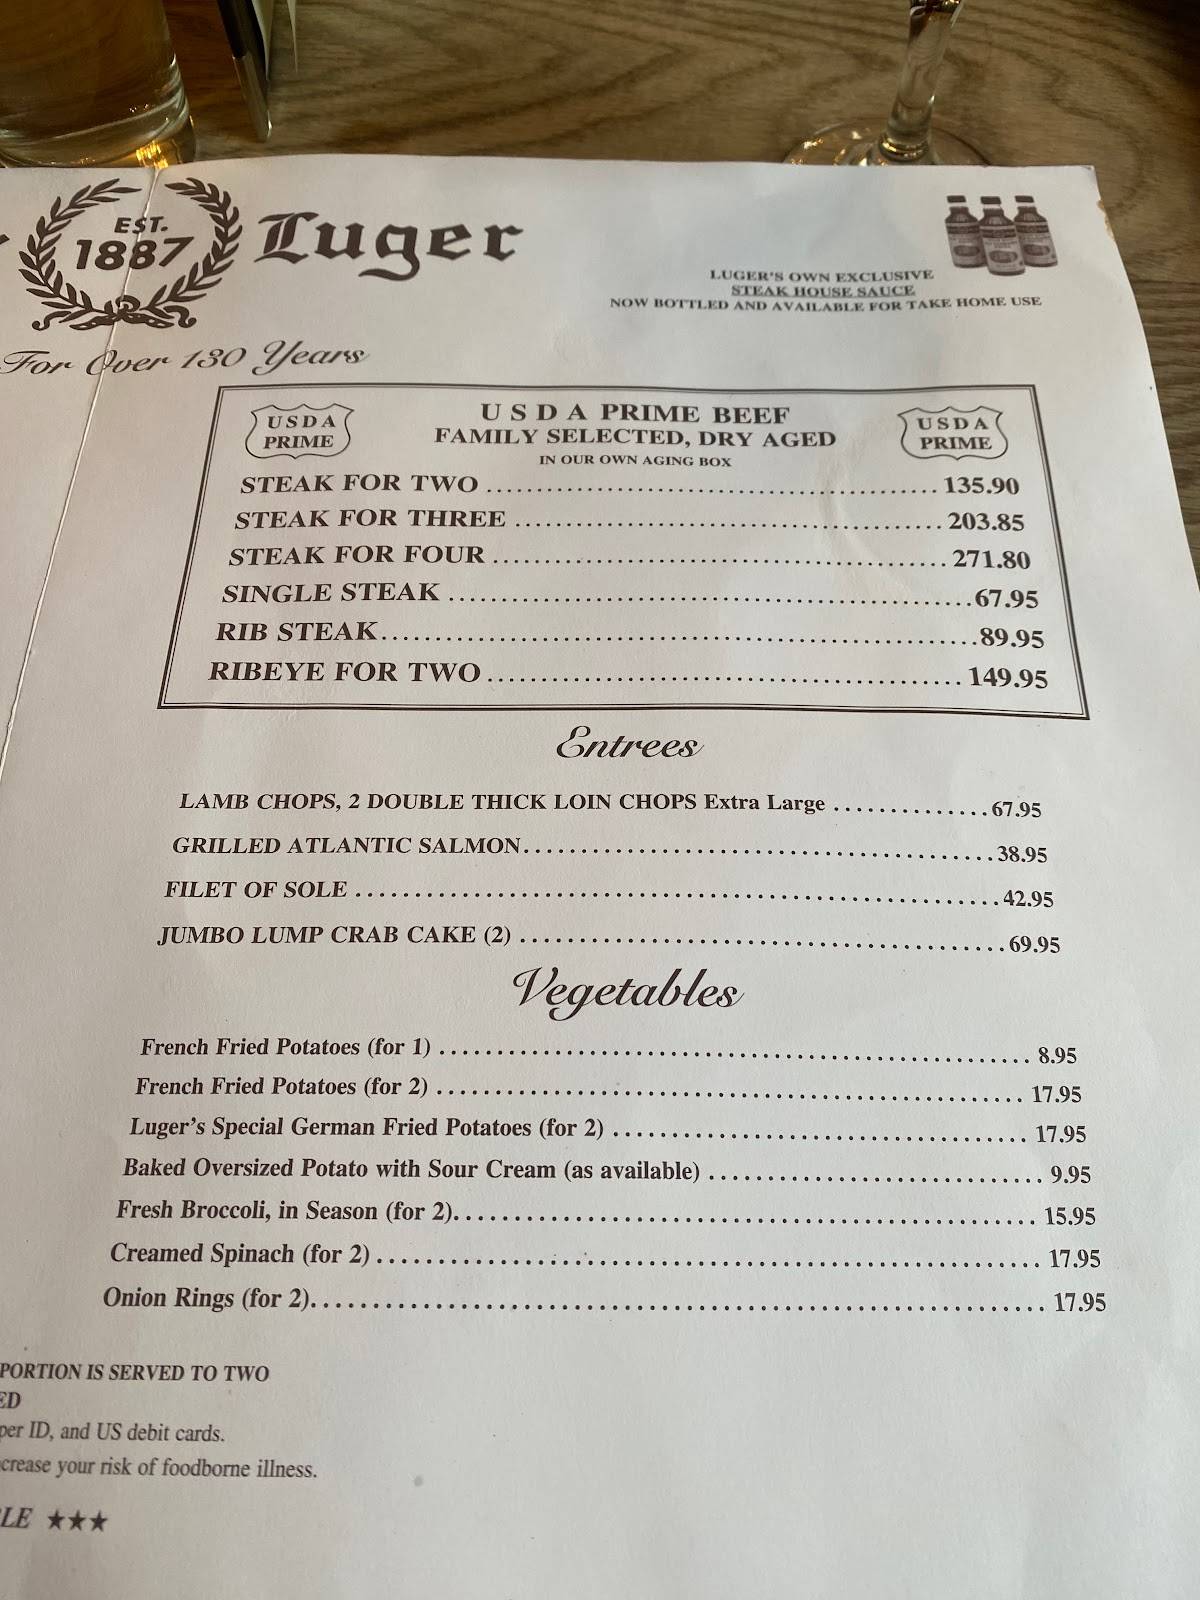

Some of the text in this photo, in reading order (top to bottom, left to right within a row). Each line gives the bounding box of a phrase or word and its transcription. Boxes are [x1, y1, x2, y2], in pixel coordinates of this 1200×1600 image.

[113, 217, 169, 234] EST.
[75, 236, 194, 270] 1887
[254, 212, 524, 281] Luger
[710, 269, 934, 283] LUGER'S OWN EXCLUSIVE
[610, 296, 1043, 313] NOW BOTTLED AND AVAILABLE FOR TAKE HOME USE
[731, 285, 916, 299] STEAK HOUSE SAUCE
[0, 340, 370, 376] For Over 130 Years
[601, 404, 700, 422] PRIME
[712, 407, 789, 424] BEEF
[263, 435, 334, 450] PRIME
[434, 428, 836, 448] FAMILY SELECTED, DRY AGED
[920, 436, 993, 451] PRIME
[539, 454, 732, 468] IN OUR OWN AGING BOX
[240, 474, 1019, 495] STEAK FOR TWO 135.90
[235, 509, 1024, 531] STEAK FOR THREE 203.85
[229, 545, 1031, 569] STEAK FOR FOUR 271.80
[222, 582, 1038, 608] SINGLE STEAK 67.95
[215, 623, 267, 641] RIB
[980, 628, 1044, 648] 89.95
[208, 662, 1048, 689] RIBEYE FOR TWO 149.95
[556, 726, 704, 759] Entrees
[179, 793, 1041, 818] LAMB CHOPS, 2 DOUBLE THICK LOIN CHOPS Extra Large 67.95
[173, 837, 280, 854] GRILLED
[286, 837, 411, 854] ATLANTIC
[997, 846, 1047, 863] 38.95
[164, 880, 1053, 908] FILET OF SOLE 42.95
[157, 925, 1060, 953] JUMBO LUMP CRAB CAKE (2) 69.95
[513, 967, 744, 1021] Vegetables
[140, 1038, 1077, 1064] French Fried Potatoes (for 1) 8.95
[135, 1076, 1081, 1103] French Fried Potatoes (for 2) 17.95
[212, 1117, 283, 1140] Special
[291, 1117, 375, 1135] German
[382, 1118, 437, 1136] Fried
[445, 1118, 531, 1136] Potatoes
[539, 1118, 577, 1140] (for
[584, 1118, 603, 1140] 2)
[1036, 1125, 1087, 1143] 17.95
[122, 1158, 1091, 1184] Baked Oversized Potato with Sour Cream (as available) 9.95
[116, 1200, 172, 1218] Fresh
[180, 1200, 271, 1223] Broccoli,
[278, 1200, 298, 1219] in
[306, 1200, 378, 1220] Season
[386, 1201, 425, 1224] (for
[1045, 1207, 1095, 1225] 15.95
[111, 1242, 1100, 1268] Creamed Spinach (for 2) 17.95
[104, 1287, 166, 1307] Onion
[174, 1287, 234, 1312] Rings
[242, 1288, 282, 1311] (for
[1054, 1292, 1106, 1312] 17.95
[0, 1363, 269, 1382] PORTION IS SERVED TO TWO
[30, 1421, 53, 1441] ID,
[61, 1423, 90, 1439] and
[98, 1423, 122, 1440] US
[127, 1423, 169, 1441] debit
[176, 1424, 224, 1442] cards.
[56, 1461, 95, 1478] your
[101, 1457, 131, 1475] risk
[138, 1457, 158, 1475] of
[162, 1458, 250, 1477] foodborne
[257, 1459, 316, 1477] illness.
